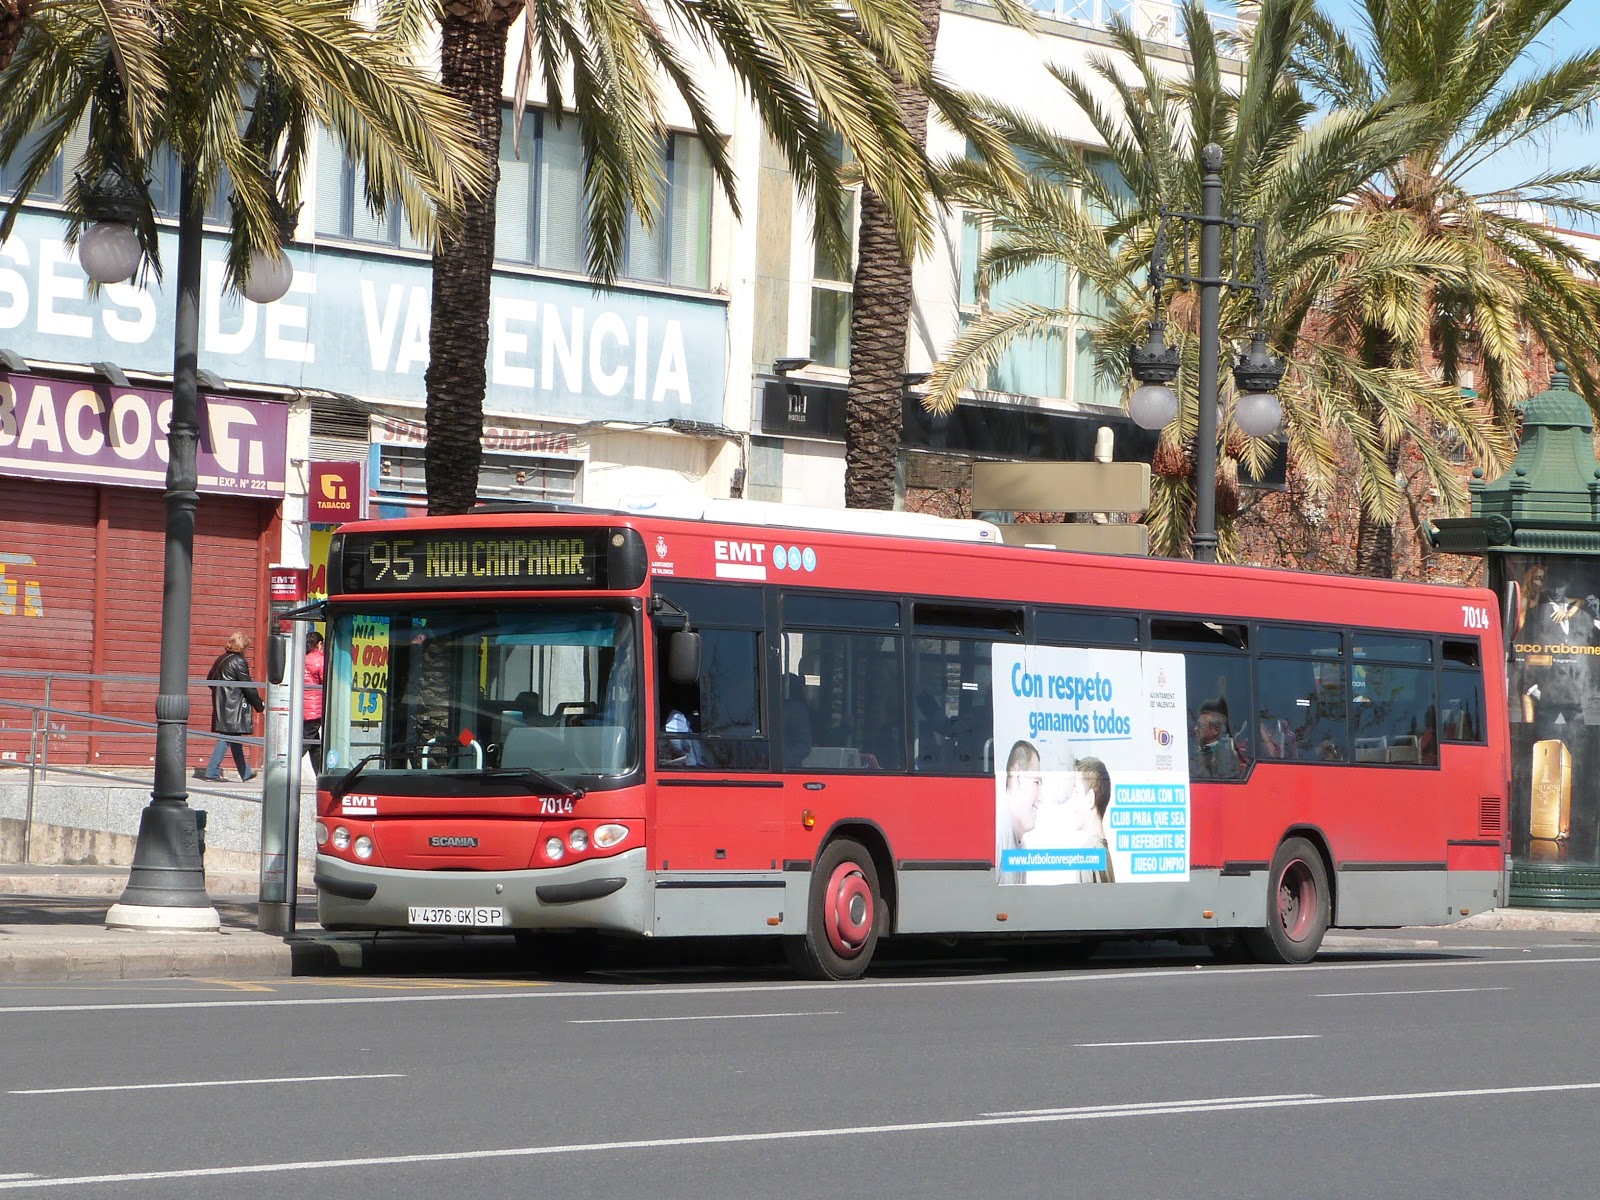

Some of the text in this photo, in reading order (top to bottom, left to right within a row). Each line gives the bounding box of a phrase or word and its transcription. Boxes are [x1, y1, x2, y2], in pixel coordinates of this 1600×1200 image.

[204, 259, 318, 363] DE
[360, 279, 692, 404] VAENCIA
[484, 428, 569, 454] OMANIA
[218, 476, 238, 488] EXP.
[250, 479, 266, 490] 222
[317, 501, 351, 510] TABACOS
[369, 540, 414, 580] 95
[426, 541, 467, 577] NOU
[472, 538, 585, 577] CAMPANAR
[714, 540, 765, 563] EMT
[271, 576, 297, 584] EMT
[1461, 605, 1489, 629] 7014
[1011, 662, 1112, 711] Con respeto
[1028, 707, 1131, 739] ganamos todos
[1117, 788, 1185, 803] COLABORA CON TU
[342, 795, 573, 815] EMT 7014
[1112, 811, 1185, 828] CLUB PARA QUE SEA
[431, 836, 476, 847] SCANIA
[1118, 834, 1185, 849] UN REFERENTE DE
[1008, 853, 1100, 866] www.futbolconrespeto.com
[1134, 857, 1185, 872] JUEGO LIMPIO
